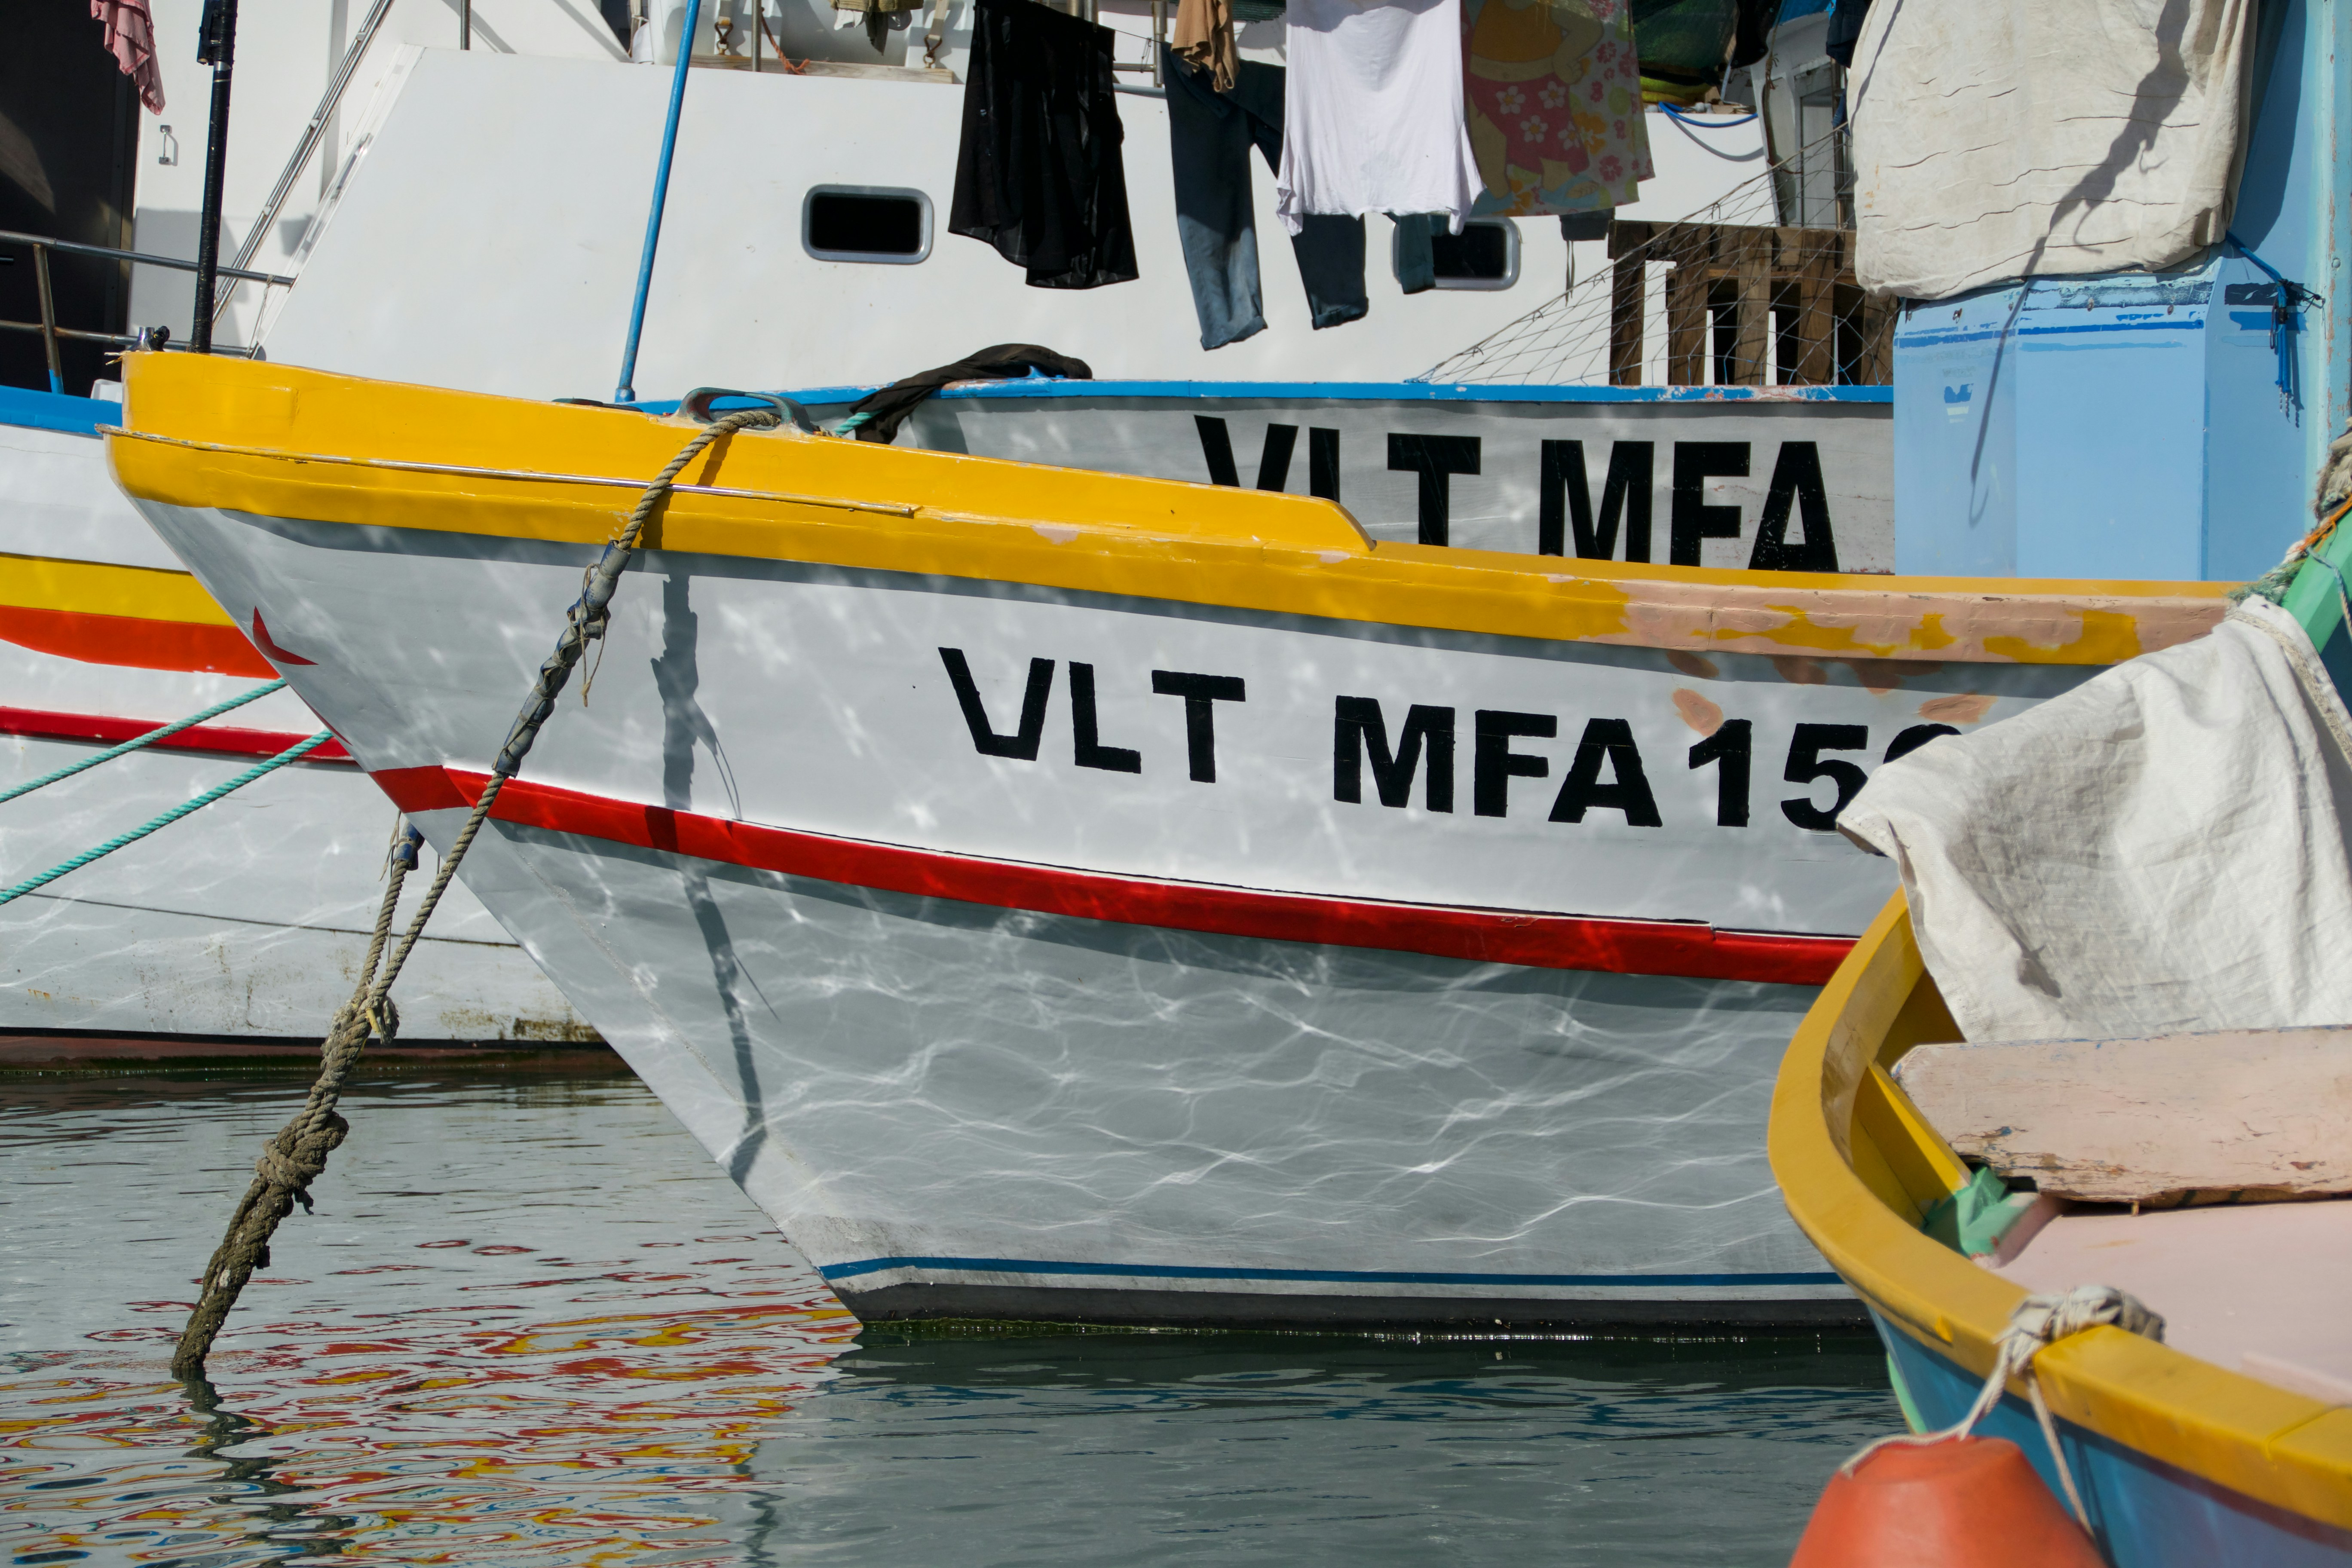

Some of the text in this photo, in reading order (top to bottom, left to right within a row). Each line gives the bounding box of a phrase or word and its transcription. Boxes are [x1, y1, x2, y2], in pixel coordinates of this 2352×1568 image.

[1540, 440, 1838, 572] MFA
[940, 647, 1961, 830] VLT MFA15
